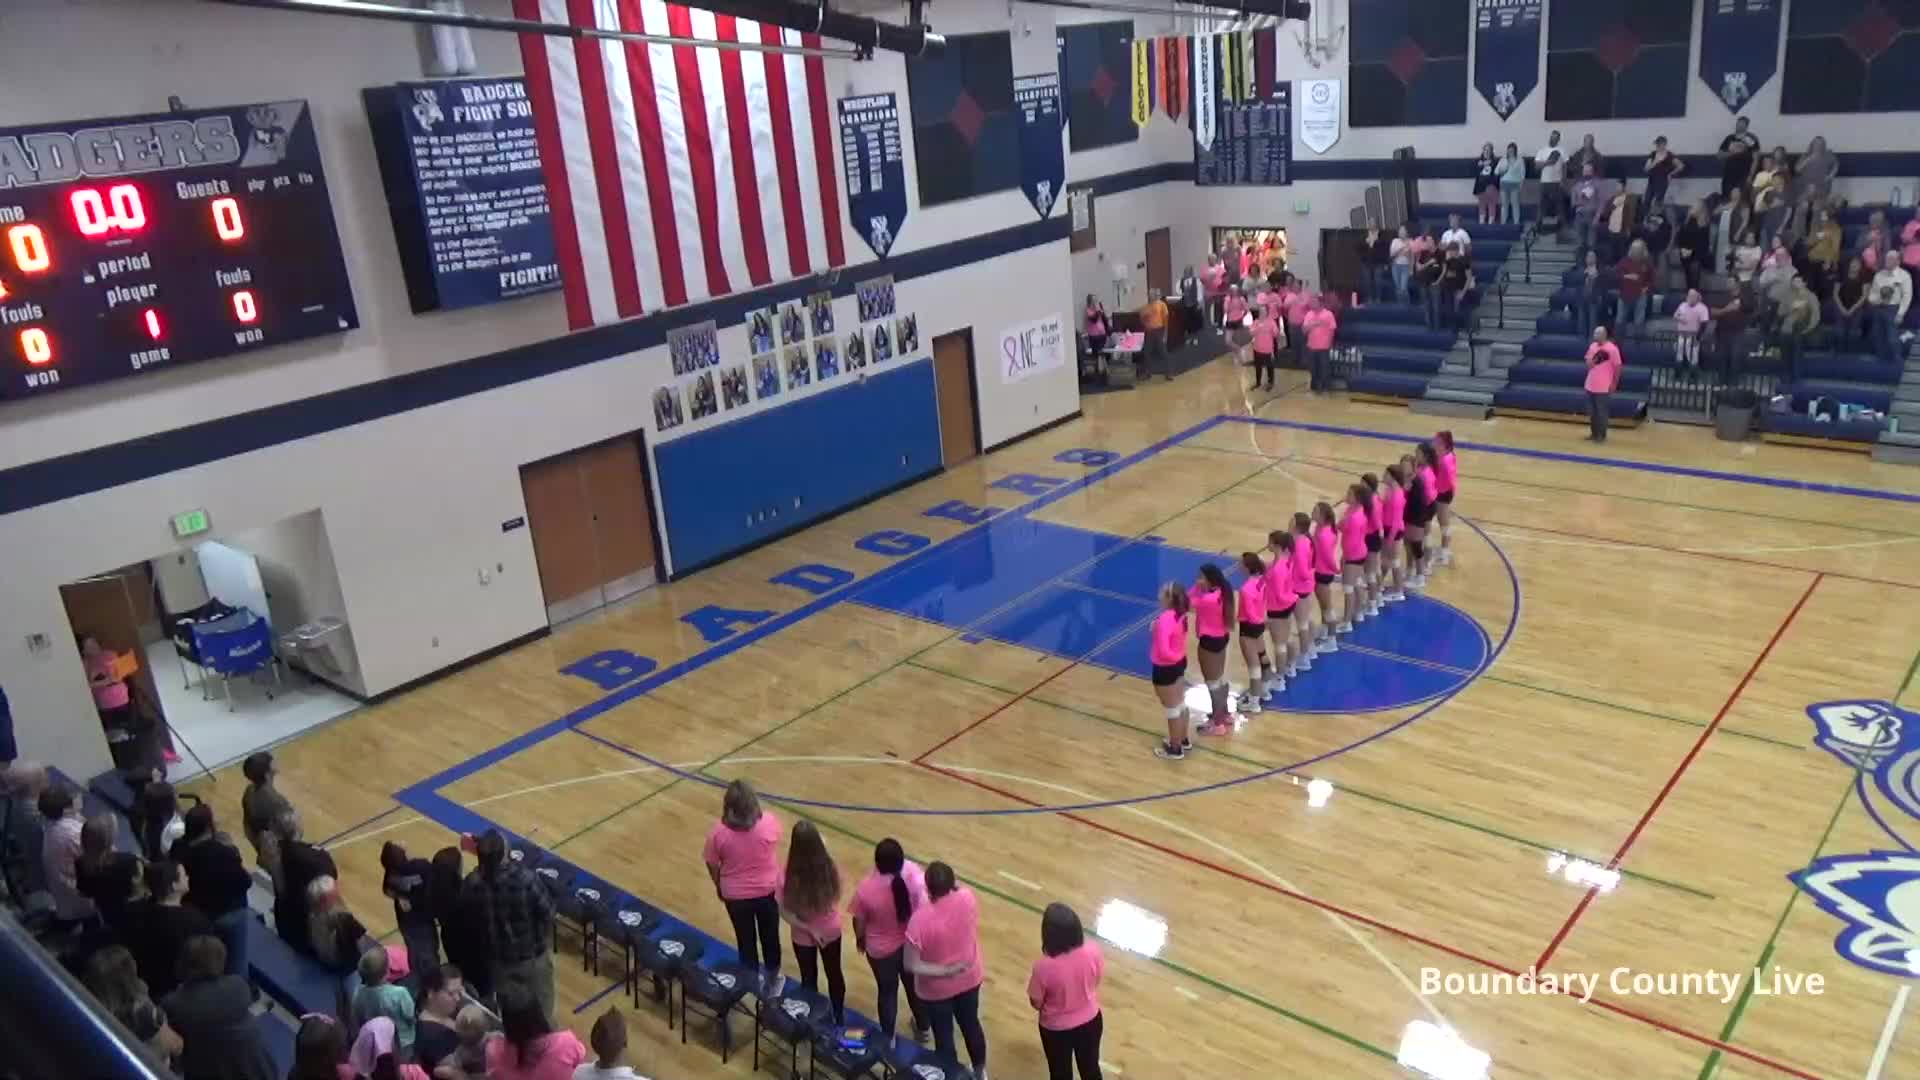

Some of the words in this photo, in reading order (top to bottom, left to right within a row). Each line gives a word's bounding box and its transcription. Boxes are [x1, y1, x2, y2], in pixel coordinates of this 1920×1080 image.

[452, 103, 501, 123] FIGHT
[840, 108, 898, 126] CHAMPIONS
[0, 116, 240, 190] ADGERS
[176, 178, 231, 200] Guests
[0, 205, 25, 224] me
[211, 198, 244, 241] 0
[8, 223, 51, 273] 0
[98, 252, 152, 279] period
[216, 267, 251, 288] fouls
[106, 282, 158, 308] player
[233, 291, 257, 322] 0
[1, 302, 44, 325] fouls
[145, 309, 161, 339] 1
[20, 327, 51, 364] 0
[234, 328, 264, 345] won
[130, 346, 171, 370] game
[25, 368, 60, 388] won
[557, 447, 1121, 692] BADGERS
